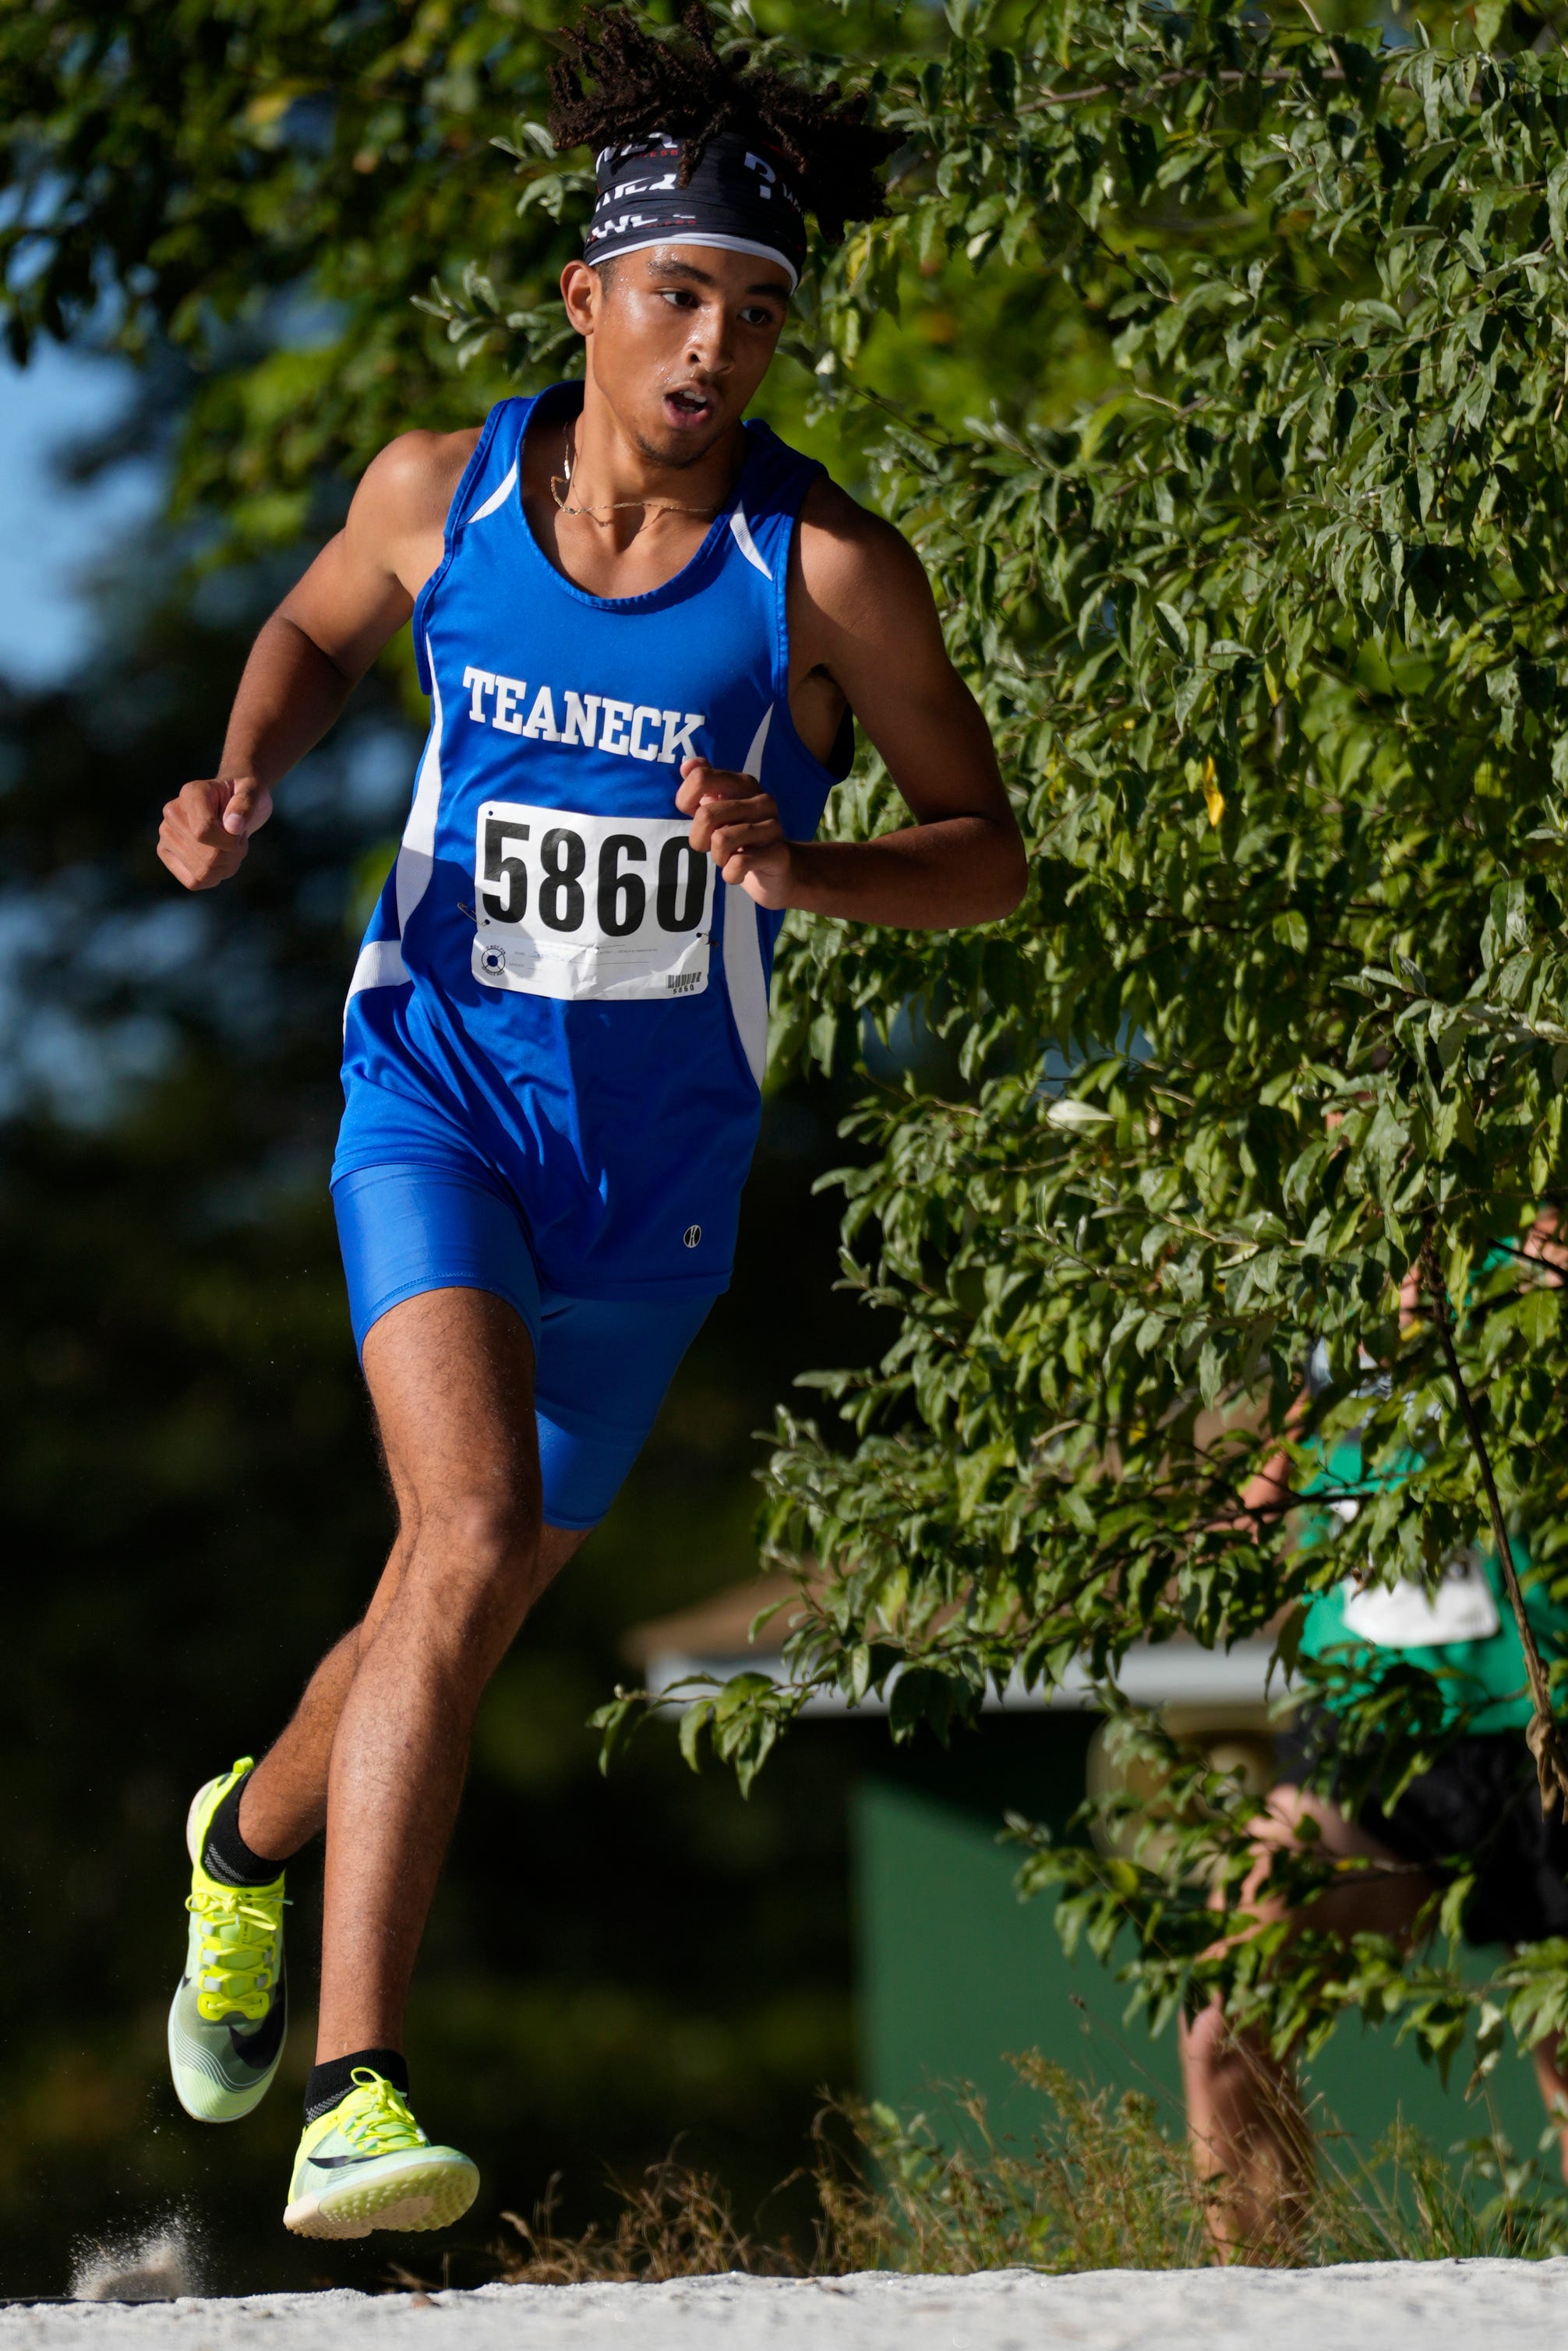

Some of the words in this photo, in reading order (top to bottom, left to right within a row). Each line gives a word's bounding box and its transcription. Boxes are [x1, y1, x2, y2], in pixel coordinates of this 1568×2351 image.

[463, 666, 705, 764] TEANECK
[482, 818, 707, 937] 5860
[673, 983, 694, 995] 5860
